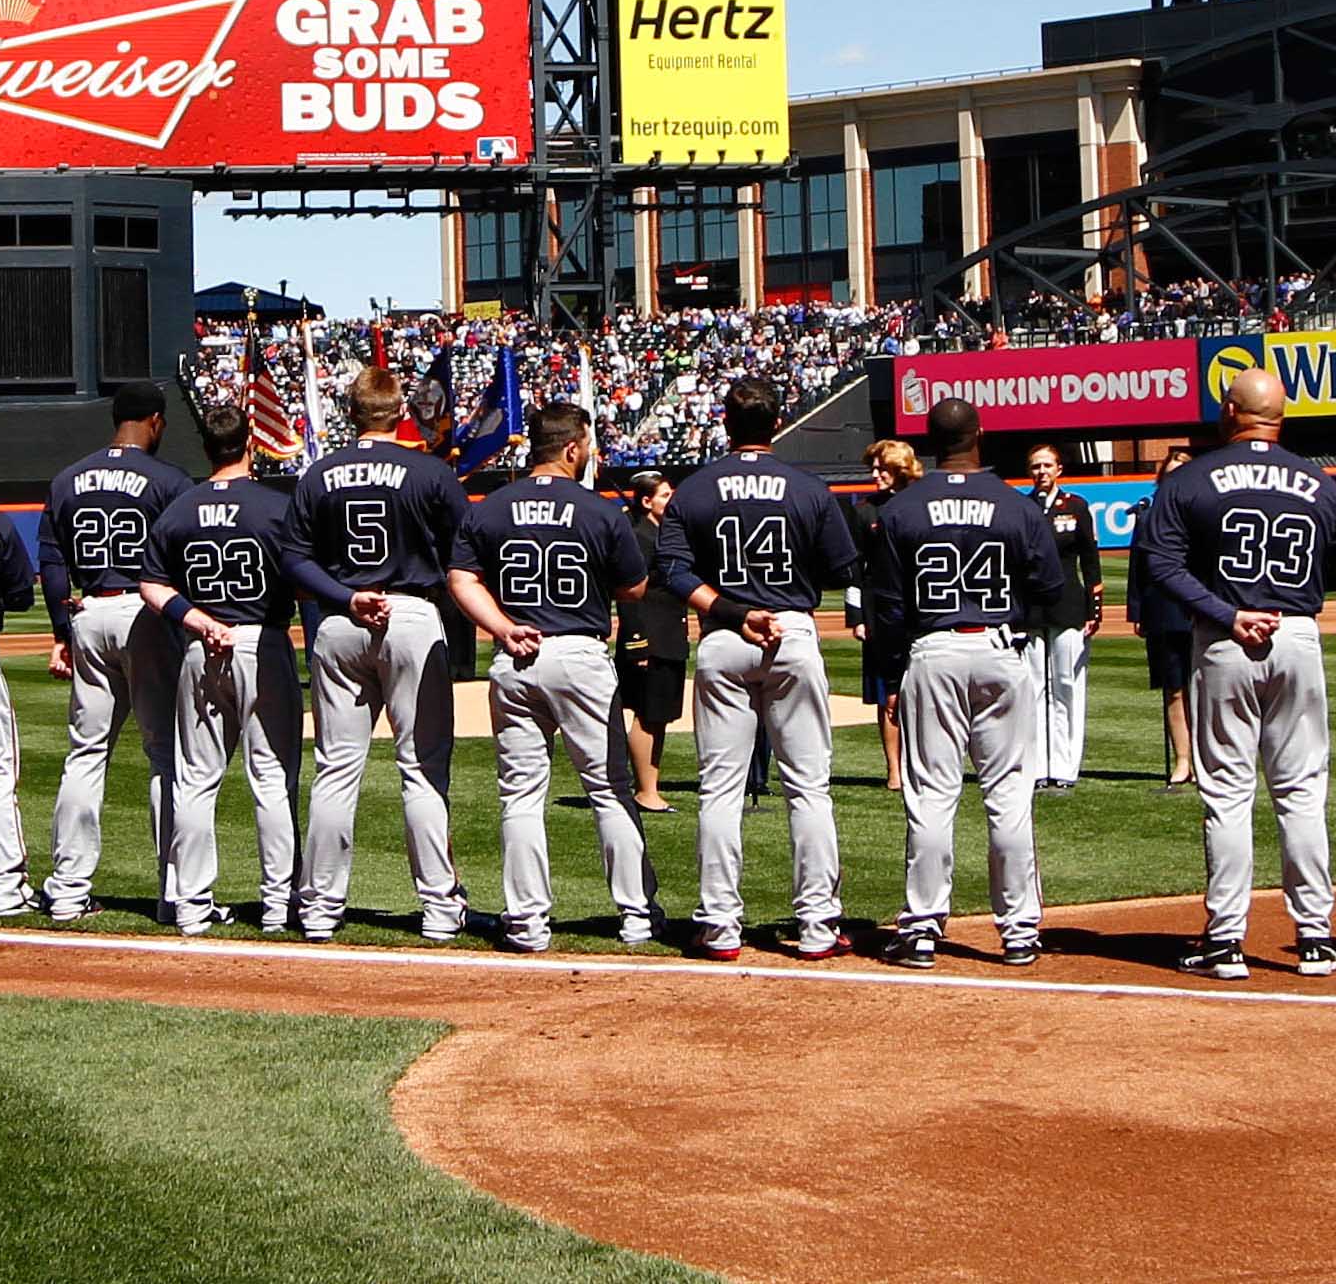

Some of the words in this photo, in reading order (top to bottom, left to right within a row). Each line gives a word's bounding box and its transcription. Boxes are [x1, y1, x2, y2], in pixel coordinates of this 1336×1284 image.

[313, 47, 450, 79] SOME
[648, 53, 714, 73] Equipment
[718, 52, 757, 69] Rental
[281, 83, 484, 132] BUDS
[630, 117, 779, 140] hertzequip.com
[1062, 368, 1187, 402] DONUTS
[74, 470, 148, 497] HEYWARD
[323, 463, 407, 492] FREEMAN
[717, 475, 786, 501] PRADO
[1210, 463, 1321, 503] GONZALEZ
[199, 504, 239, 527] DIAZ
[512, 501, 573, 528] UGGLA
[928, 500, 995, 528] BOURN
[74, 508, 147, 569] 22
[347, 501, 388, 565] 5
[1219, 510, 1316, 589] 33
[716, 517, 792, 585] 14
[184, 539, 266, 603] 23
[500, 540, 588, 608] 26
[916, 542, 1011, 614] 24
